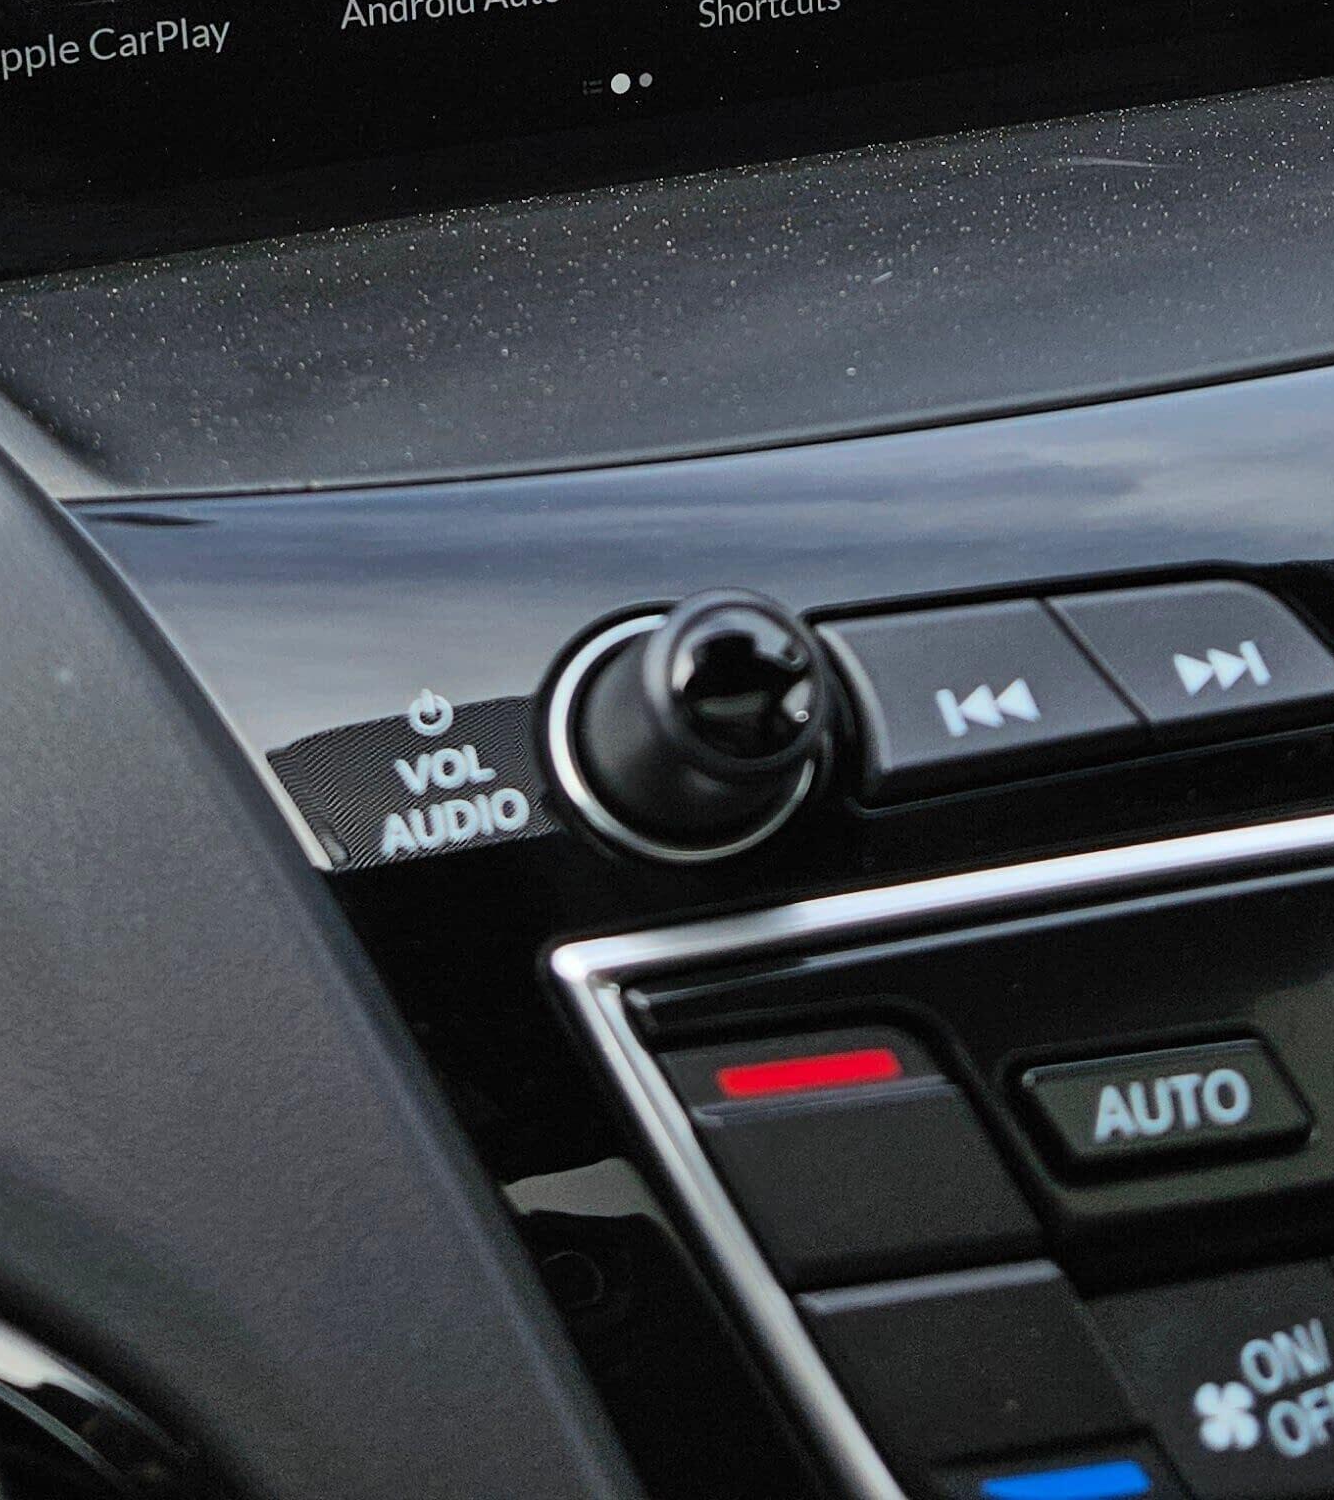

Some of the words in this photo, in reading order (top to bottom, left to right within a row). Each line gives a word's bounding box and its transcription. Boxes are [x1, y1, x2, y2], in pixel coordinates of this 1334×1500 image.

[89, 17, 231, 62] CarPlay
[394, 744, 497, 796] VOL
[381, 787, 530, 855] AUDIO
[1092, 1068, 1252, 1143] AUTO
